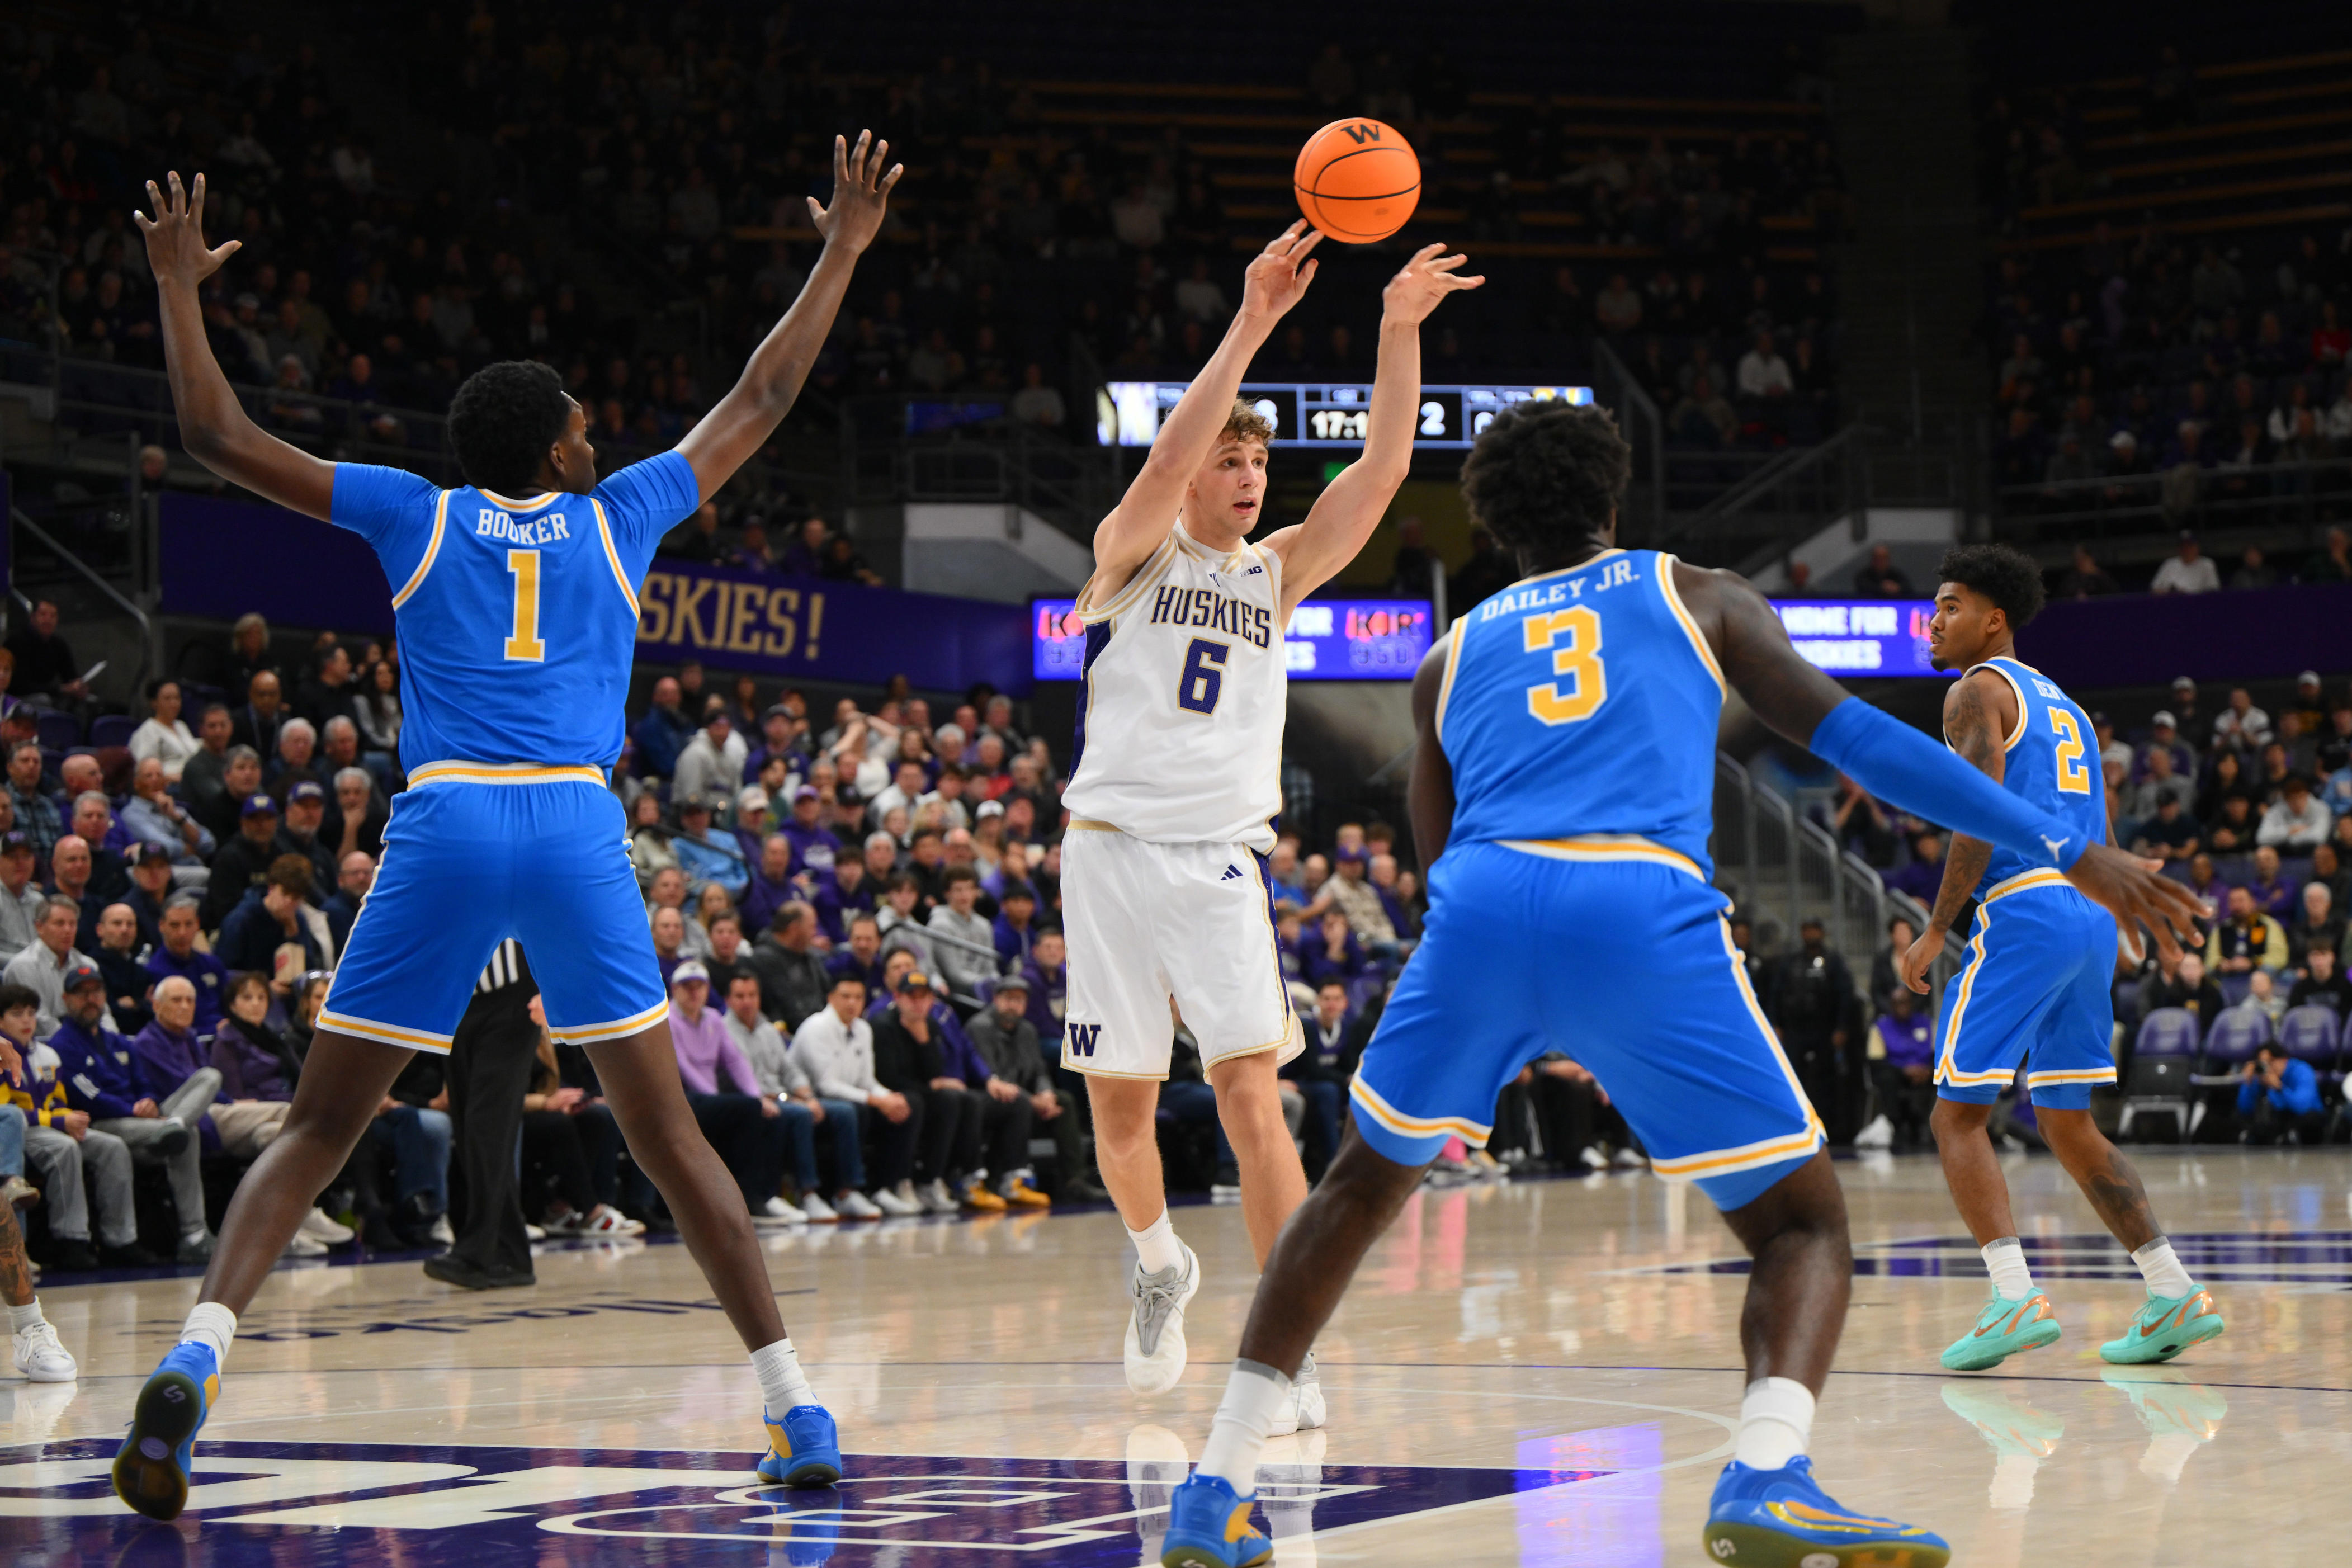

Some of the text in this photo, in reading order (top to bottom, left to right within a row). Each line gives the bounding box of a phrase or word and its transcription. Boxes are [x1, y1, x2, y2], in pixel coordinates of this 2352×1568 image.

[1340, 124, 1380, 145] W
[1311, 410, 1369, 440] 17:1
[1420, 402, 1446, 436] 2
[475, 508, 570, 545] BOOKER
[504, 549, 545, 663] 1
[636, 571, 825, 661] SKIES!
[1149, 584, 1272, 650] HUSKIES
[1480, 559, 1641, 622] DAILEY JR.
[1177, 635, 1232, 717] 6
[1522, 604, 1608, 726] 3
[2047, 706, 2091, 795] 2
[1068, 1022, 1102, 1057] W
